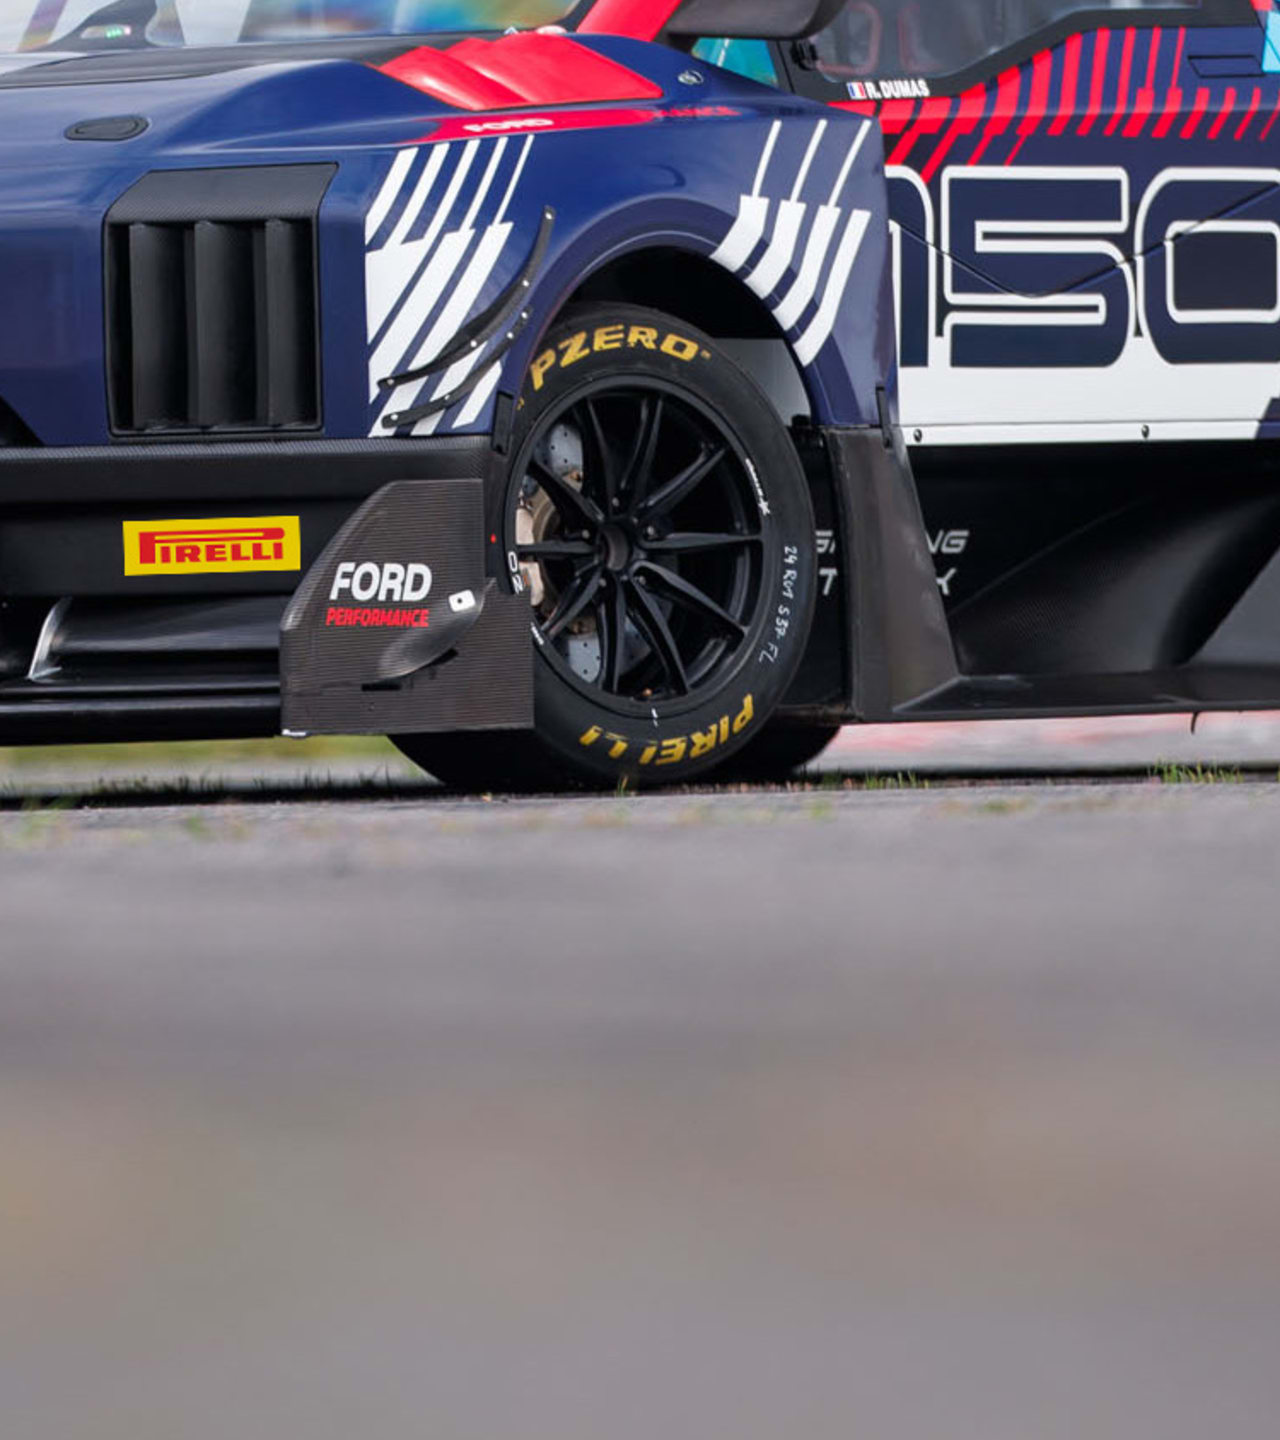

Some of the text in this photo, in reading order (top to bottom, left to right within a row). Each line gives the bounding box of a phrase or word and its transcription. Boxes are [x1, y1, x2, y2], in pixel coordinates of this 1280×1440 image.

[865, 79, 930, 99] R. DUMAS
[138, 527, 285, 565] PIRELLI
[329, 562, 433, 602] FORD
[325, 607, 430, 628] PERFORMANCE
